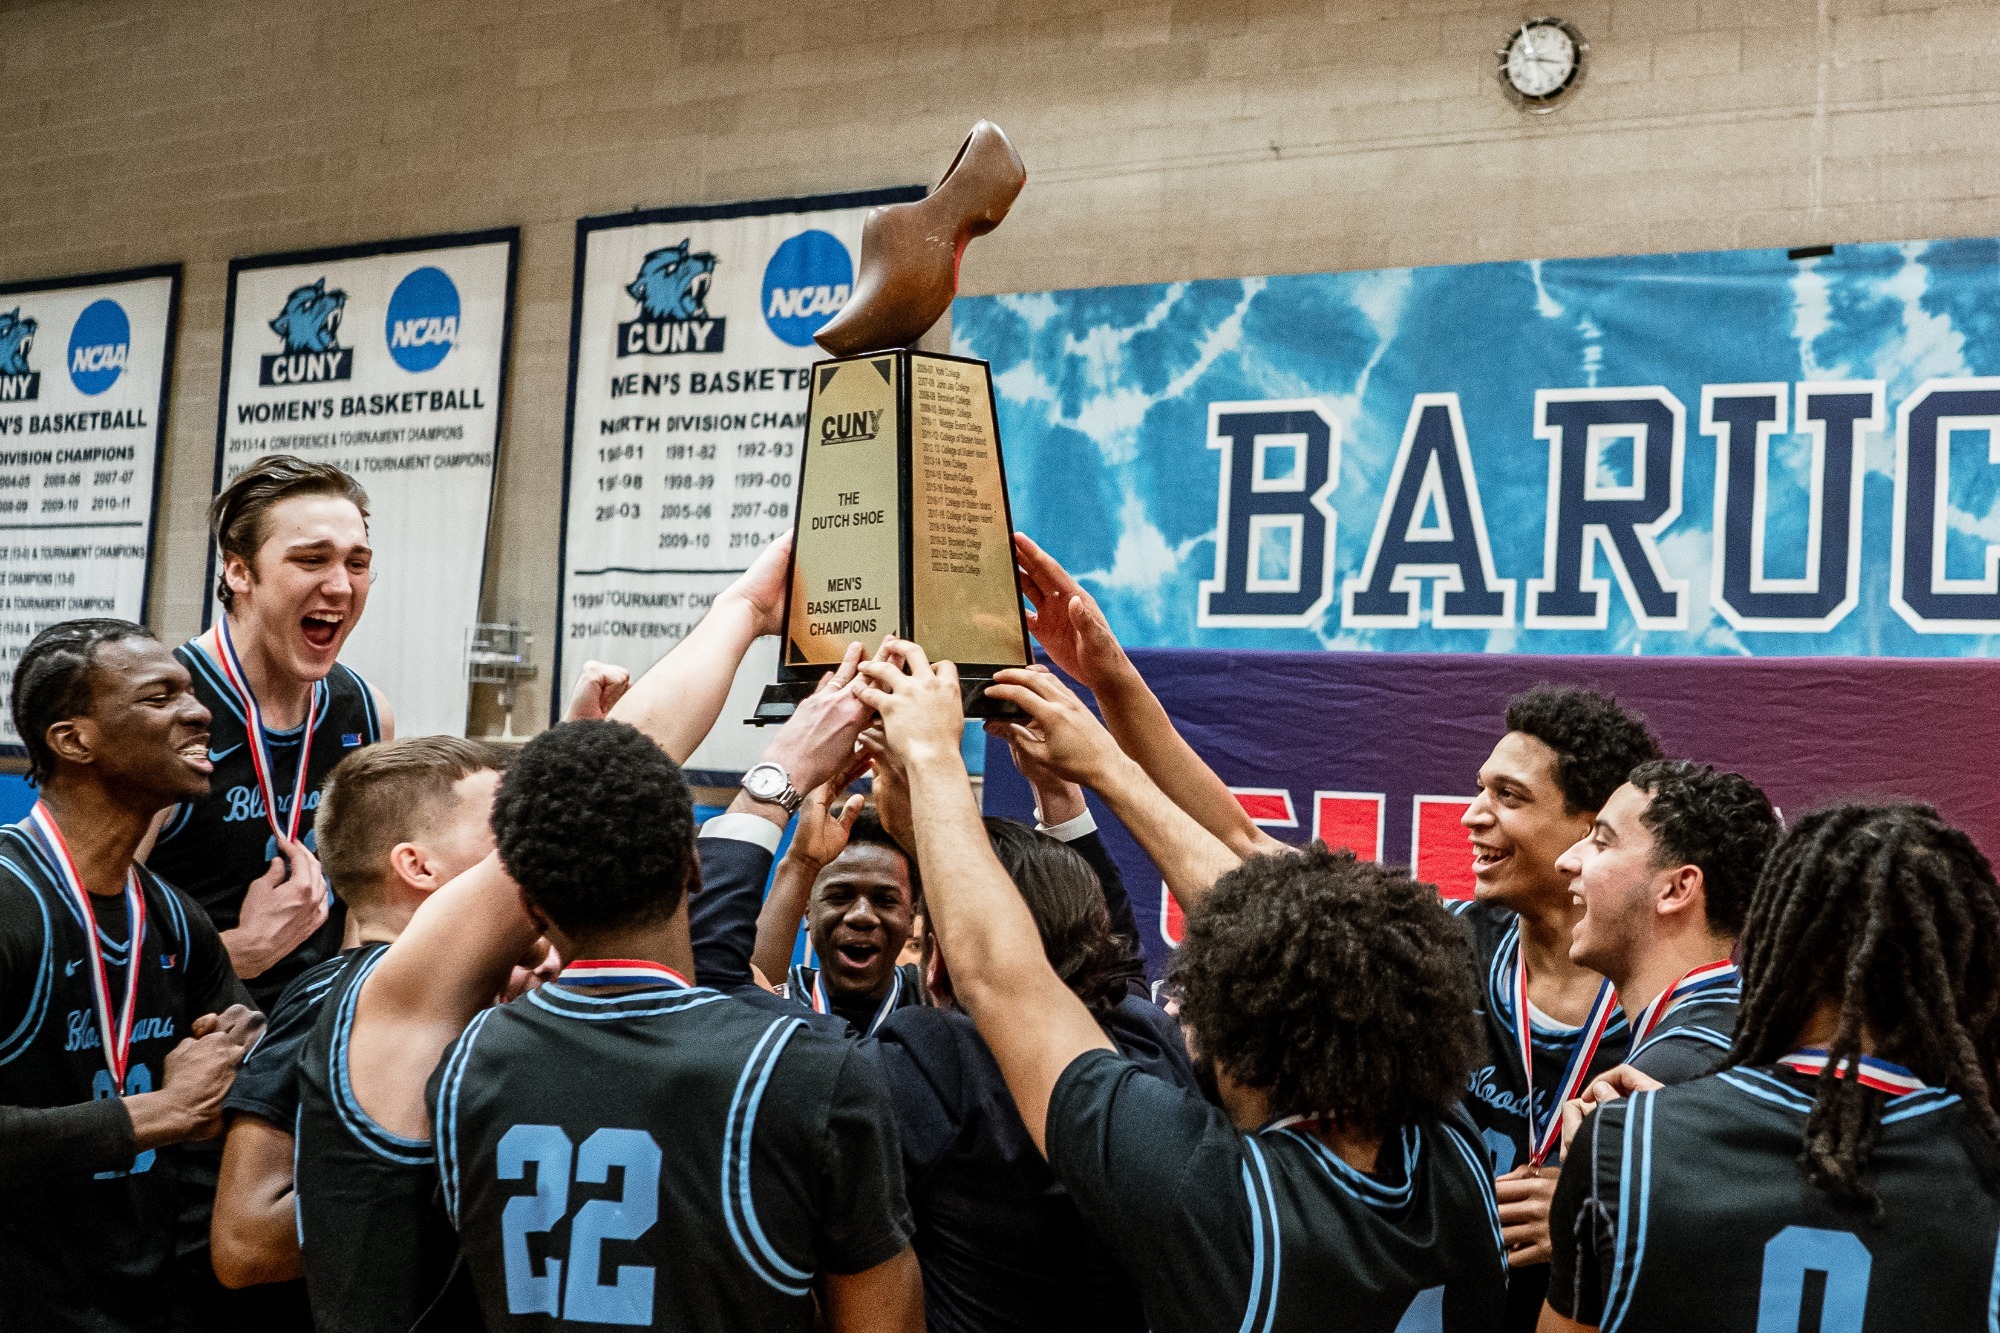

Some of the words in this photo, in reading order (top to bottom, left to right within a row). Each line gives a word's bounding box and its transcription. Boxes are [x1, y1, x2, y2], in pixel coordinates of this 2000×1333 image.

[769, 284, 851, 319] NCAA
[391, 316, 457, 349] NCAA
[627, 321, 714, 353] CUNY
[72, 343, 128, 374] NCAA
[271, 352, 342, 384] CUNY
[2, 374, 31, 399] NY
[611, 371, 680, 399] MEN'S
[690, 367, 810, 395] BASKETB
[238, 398, 334, 425] WOMEN'S
[341, 387, 485, 417] BASKETBALL
[0, 414, 23, 436] N'S
[29, 407, 147, 435] BASKETBALL
[667, 414, 746, 432] DIVISION
[751, 412, 807, 429] CHAM
[822, 408, 884, 440] CUNY
[340, 427, 405, 447] TOURNAMENT
[56, 445, 135, 464] CHAMPIONS
[364, 454, 431, 473] TOURNAMENT
[838, 491, 860, 507] THE
[1199, 377, 2000, 635] BARUC
[812, 513, 850, 531] DUTCH
[852, 510, 885, 527] SHOE
[729, 532, 775, 549] 2010-1
[827, 576, 862, 593] MEN'S
[807, 597, 881, 616] BASKETBALL
[810, 618, 877, 637] CHAMPIONS
[497, 1124, 663, 1326] 22
